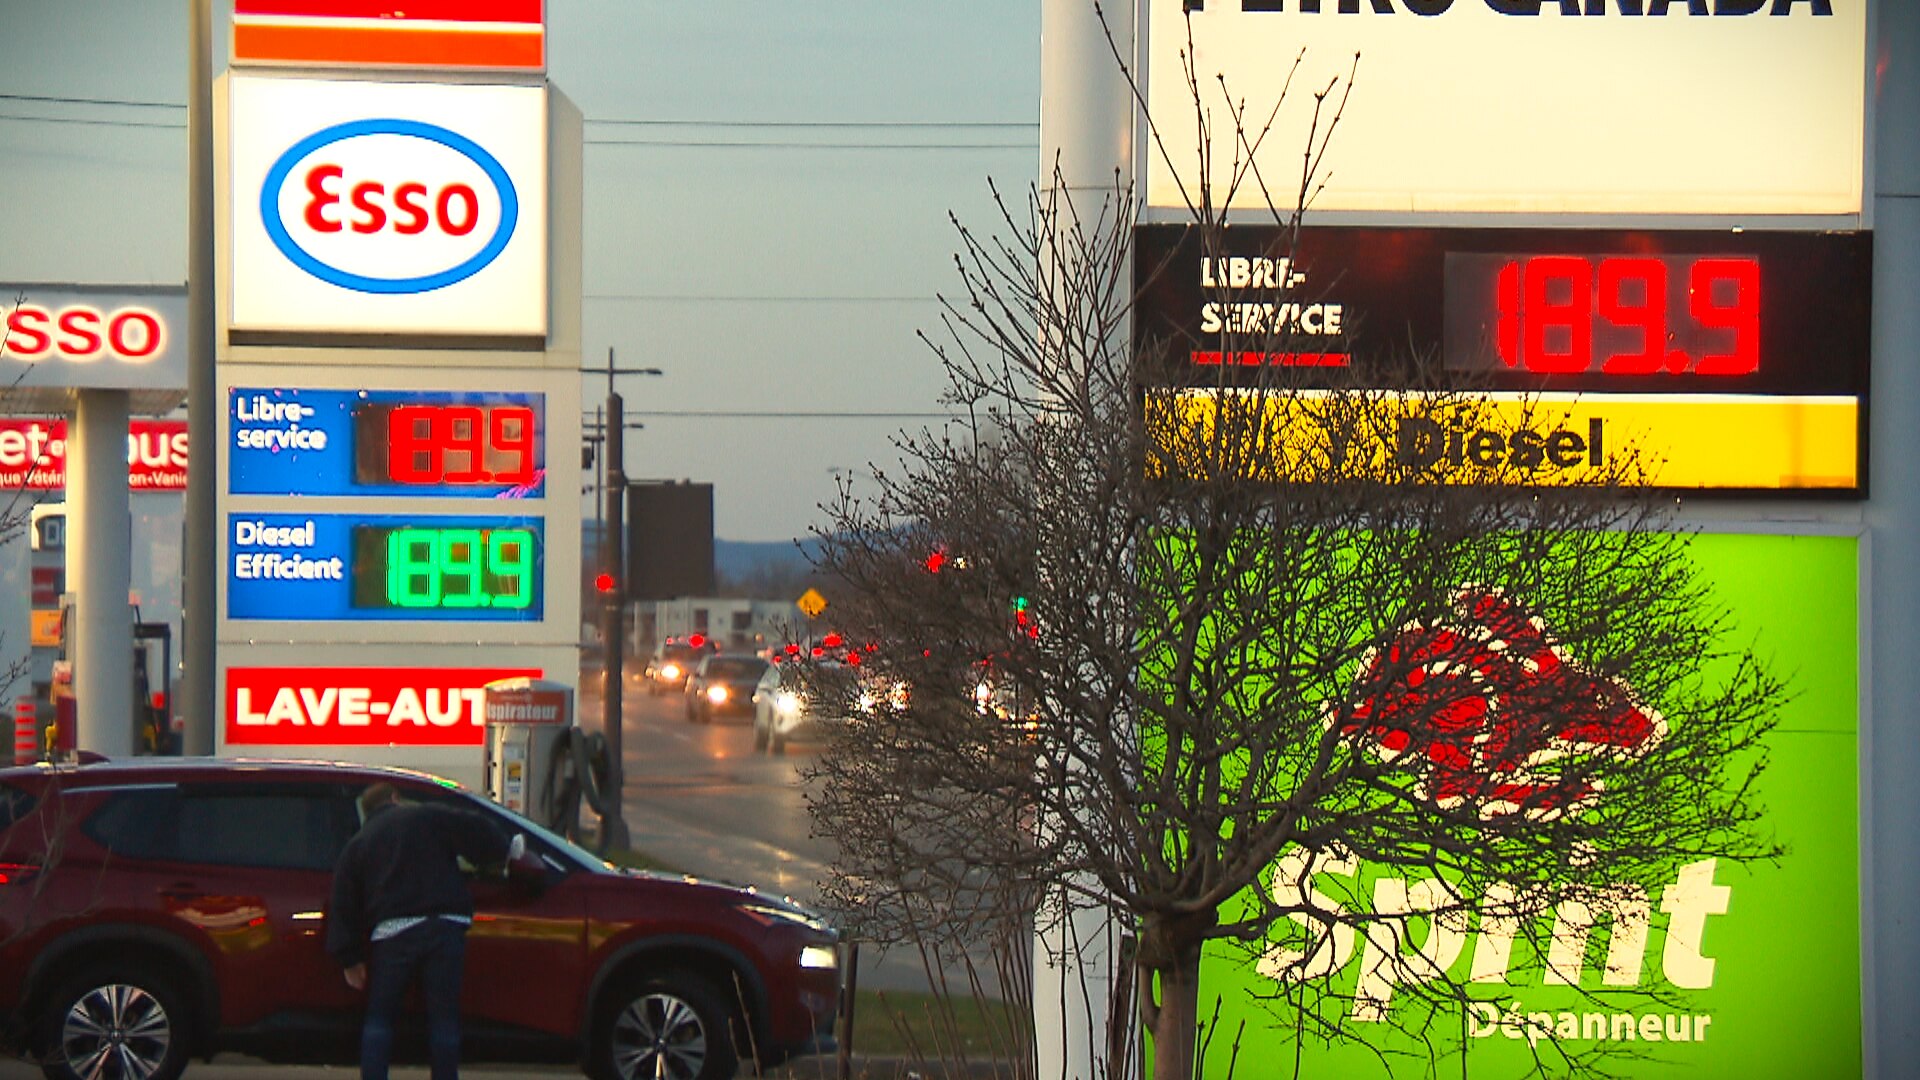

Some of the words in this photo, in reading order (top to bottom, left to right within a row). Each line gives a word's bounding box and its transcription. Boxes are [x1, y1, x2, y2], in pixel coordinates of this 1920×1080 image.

[304, 163, 479, 236] Esso
[0, 307, 162, 358] sso
[1496, 256, 1761, 375] 189.9
[236, 396, 315, 422] Libre-
[236, 427, 327, 450] service
[1397, 417, 1603, 468] Diesel
[235, 521, 316, 547] Diesel
[234, 554, 344, 580] Efficient
[487, 703, 558, 721] spirateur
[1467, 1001, 1712, 1050] Dépanneur
